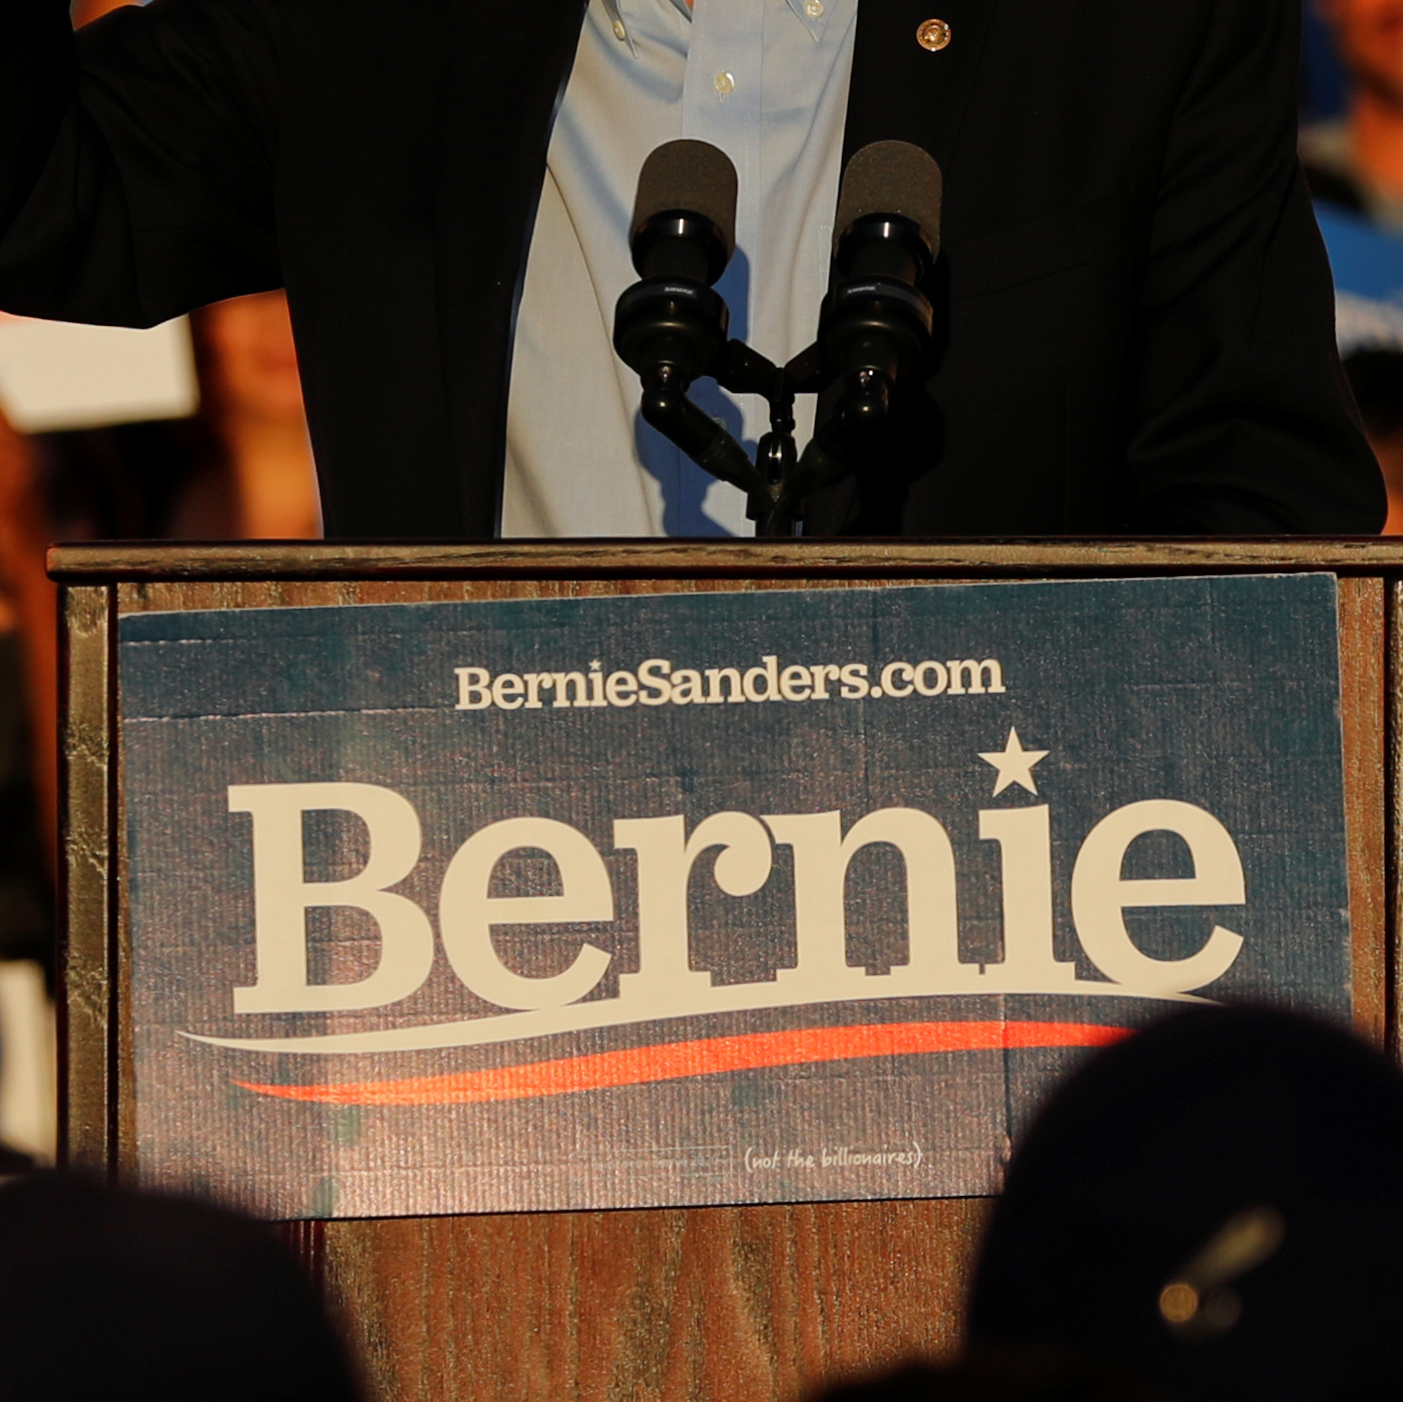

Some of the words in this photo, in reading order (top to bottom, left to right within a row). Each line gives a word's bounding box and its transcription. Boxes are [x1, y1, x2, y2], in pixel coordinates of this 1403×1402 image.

[454, 655, 1005, 710] BernieSanders.com
[226, 724, 1247, 1014] Bernie
[744, 1147, 780, 1174] (not
[787, 1149, 815, 1169] the
[821, 1141, 922, 1169] billionaires)
